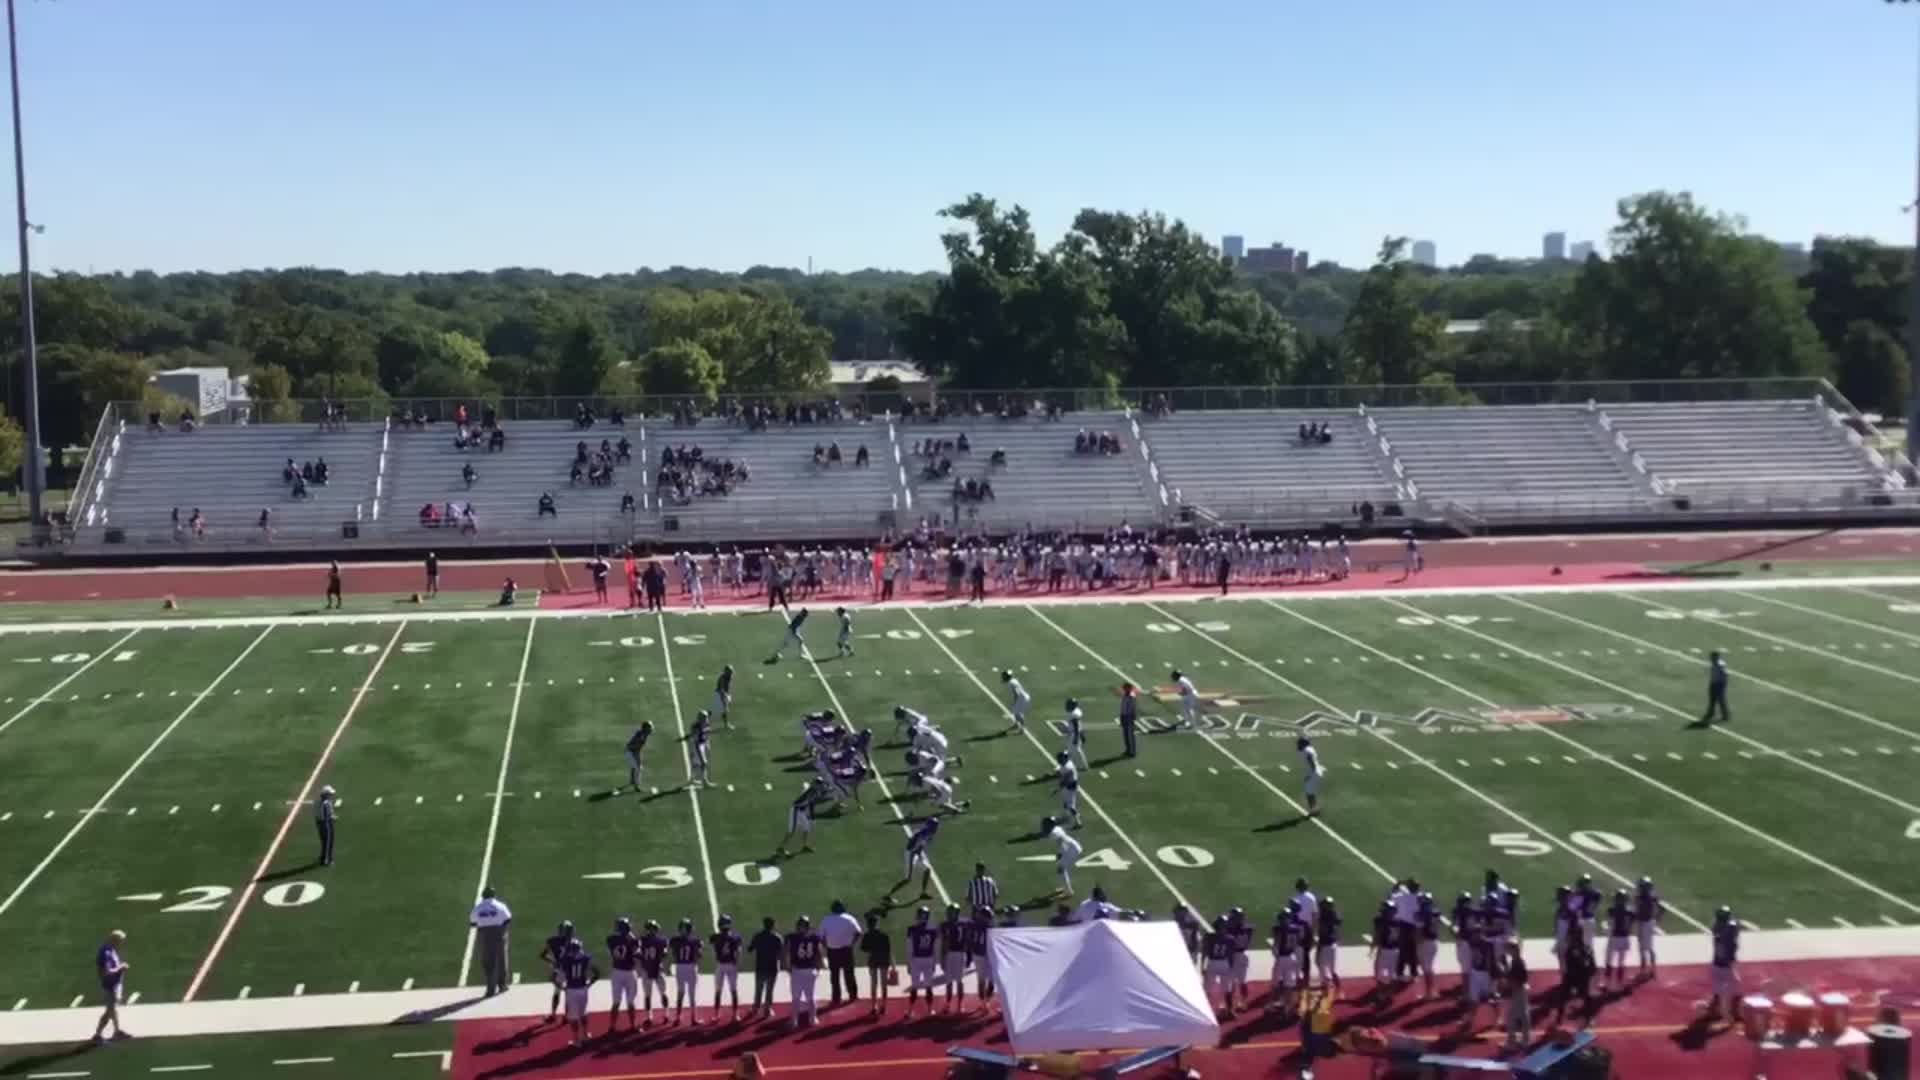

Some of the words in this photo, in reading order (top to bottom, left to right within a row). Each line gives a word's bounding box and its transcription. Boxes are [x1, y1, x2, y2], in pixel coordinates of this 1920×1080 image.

[1488, 830, 1636, 856] 50
[1074, 845, 1216, 871] 40
[635, 862, 782, 889] 30
[159, 880, 326, 912] 20
